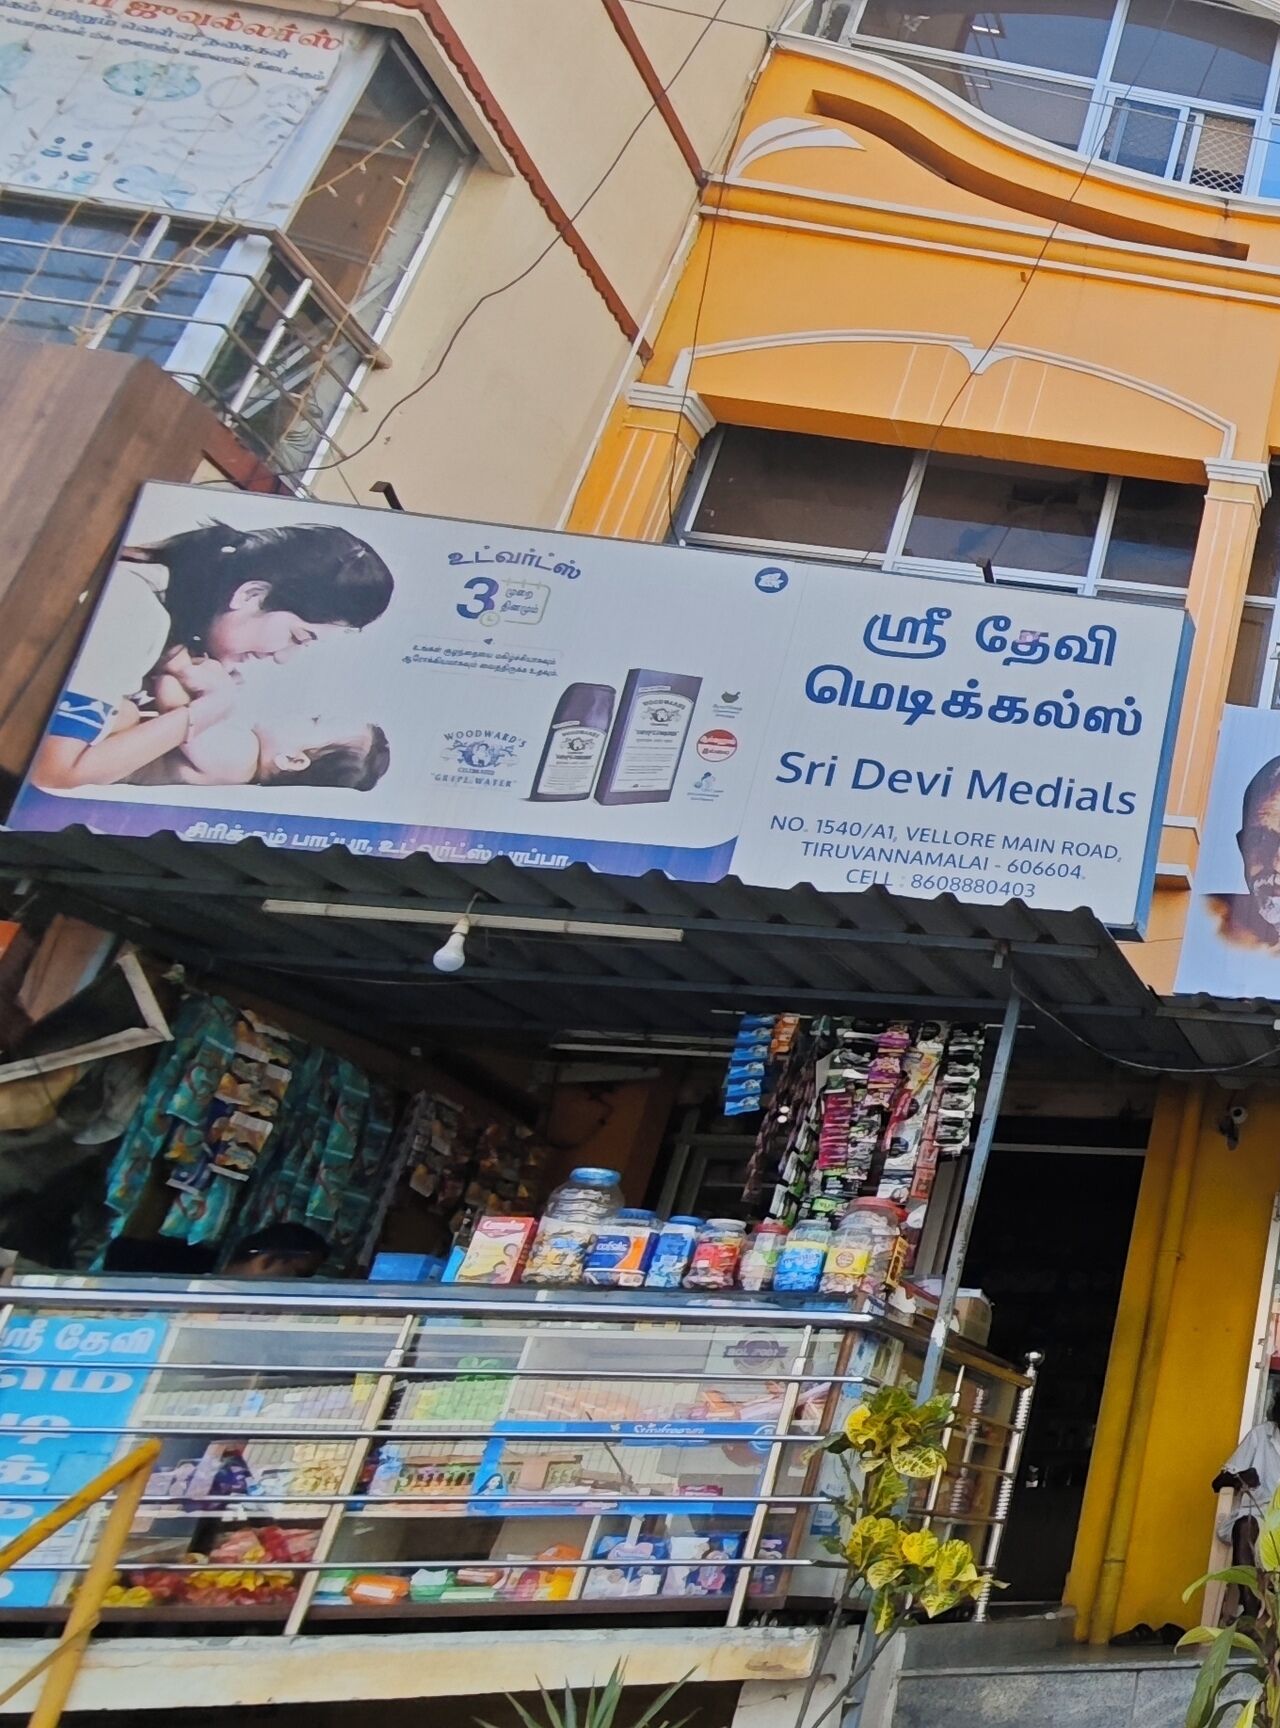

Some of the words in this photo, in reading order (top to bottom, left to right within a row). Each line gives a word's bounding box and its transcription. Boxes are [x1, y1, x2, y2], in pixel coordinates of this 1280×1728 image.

[456, 576, 499, 619] 3
[863, 606, 953, 660] ஸ்ரீ
[974, 614, 1118, 667] தேவி
[804, 664, 1143, 737] மெடிக்கல்ஸ்
[776, 751, 838, 787] Sri
[850, 757, 954, 798] Devi
[966, 768, 1137, 815] Medials
[770, 815, 809, 832] NO.
[815, 819, 898, 842] 1540/A1,
[906, 826, 996, 848] VELLORE
[1001, 835, 1055, 855] MAIN
[1061, 842, 1122, 863] ROAD,
[801, 841, 989, 871] TIRUVANNAMALAI
[845, 868, 894, 888] CELL
[910, 873, 1036, 898] 8608880403
